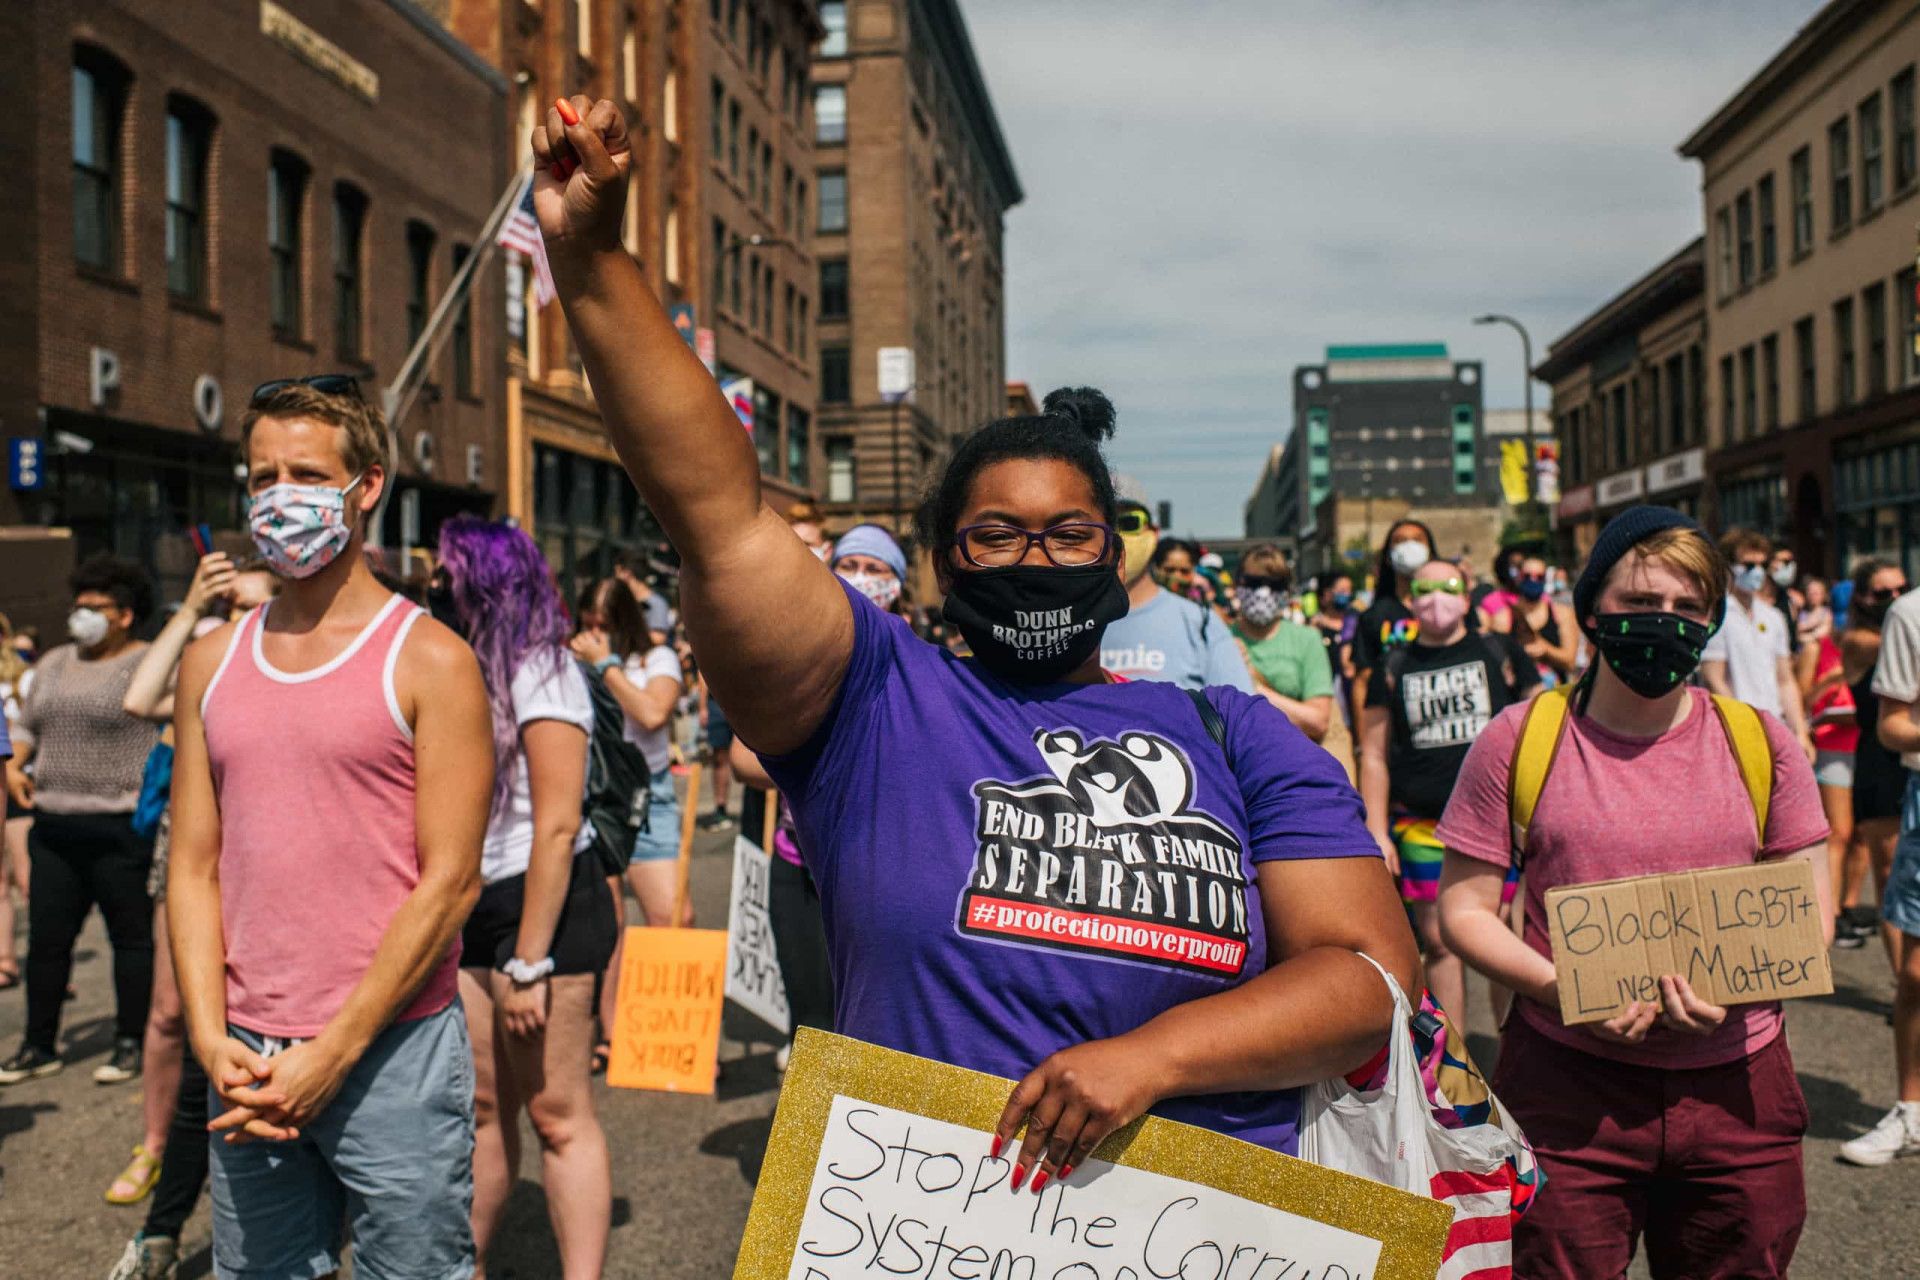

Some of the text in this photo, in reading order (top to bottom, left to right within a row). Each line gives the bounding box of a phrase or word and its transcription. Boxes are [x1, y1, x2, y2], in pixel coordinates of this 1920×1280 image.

[1014, 606, 1073, 630] DUNN
[1017, 639, 1069, 661] COFFEE
[1406, 664, 1486, 699] BLACK
[1421, 692, 1475, 720] LIVES
[983, 800, 1045, 841] END
[1151, 834, 1244, 881] FAMILY
[979, 843, 1247, 935] SEPARATION
[1556, 886, 1813, 955] Black LGBT+
[973, 903, 1243, 967] #protectionoverprofit
[1573, 944, 1817, 1014] Live Matter
[827, 1109, 1011, 1213] Stop
